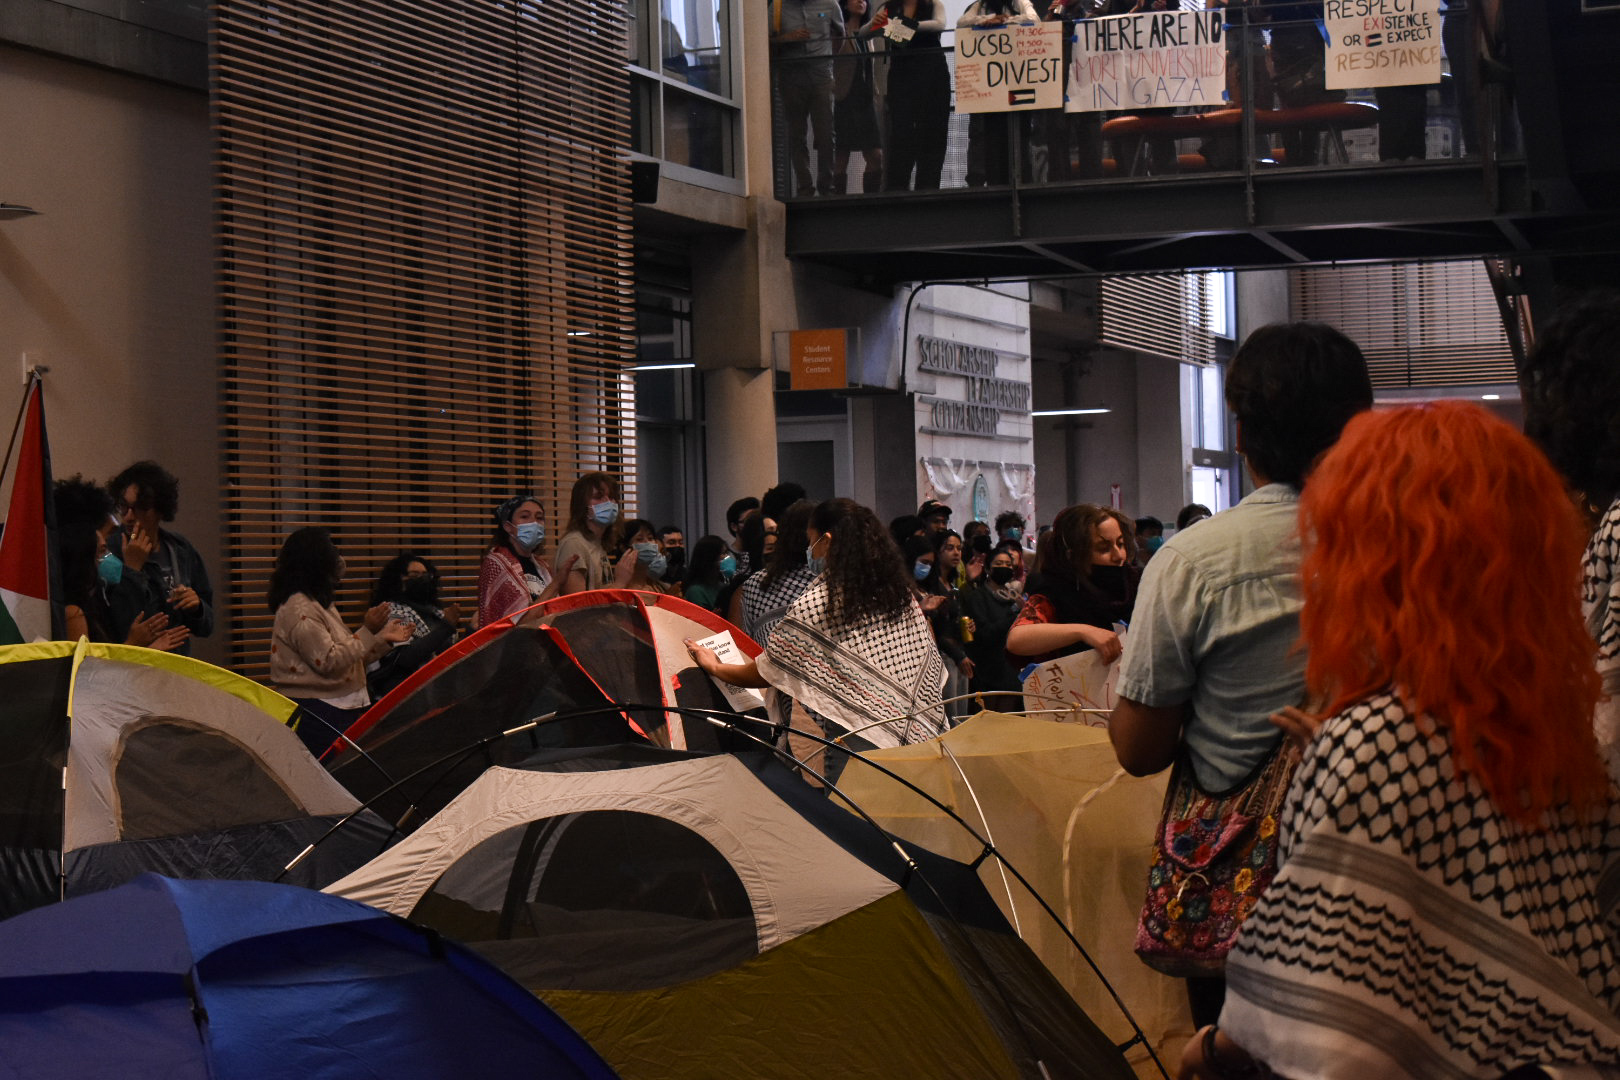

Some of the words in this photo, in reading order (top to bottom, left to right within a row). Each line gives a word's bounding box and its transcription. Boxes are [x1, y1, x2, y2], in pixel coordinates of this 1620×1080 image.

[1081, 16, 1144, 51] THERE
[1150, 13, 1188, 48] ARE
[1195, 11, 1222, 45] NO
[1343, 35, 1361, 46] OR
[1387, 26, 1432, 43] EXPECT
[1363, 12, 1429, 31] EXISTENCE
[961, 34, 1012, 58] UCSB
[1335, 45, 1439, 72] RESISTANCE
[987, 58, 1060, 87] DIVEST
[1075, 53, 1121, 82] MORE
[1129, 46, 1225, 79] UNIVERSITIES
[1093, 82, 1119, 108] IN
[1131, 76, 1205, 105] GAZA
[804, 345, 831, 353] Student
[919, 337, 998, 377] SCHOLARSHIP
[968, 375, 1030, 410] LEADERSHIP
[931, 400, 1000, 434] CITIZENSHIP
[718, 641, 731, 649] know
